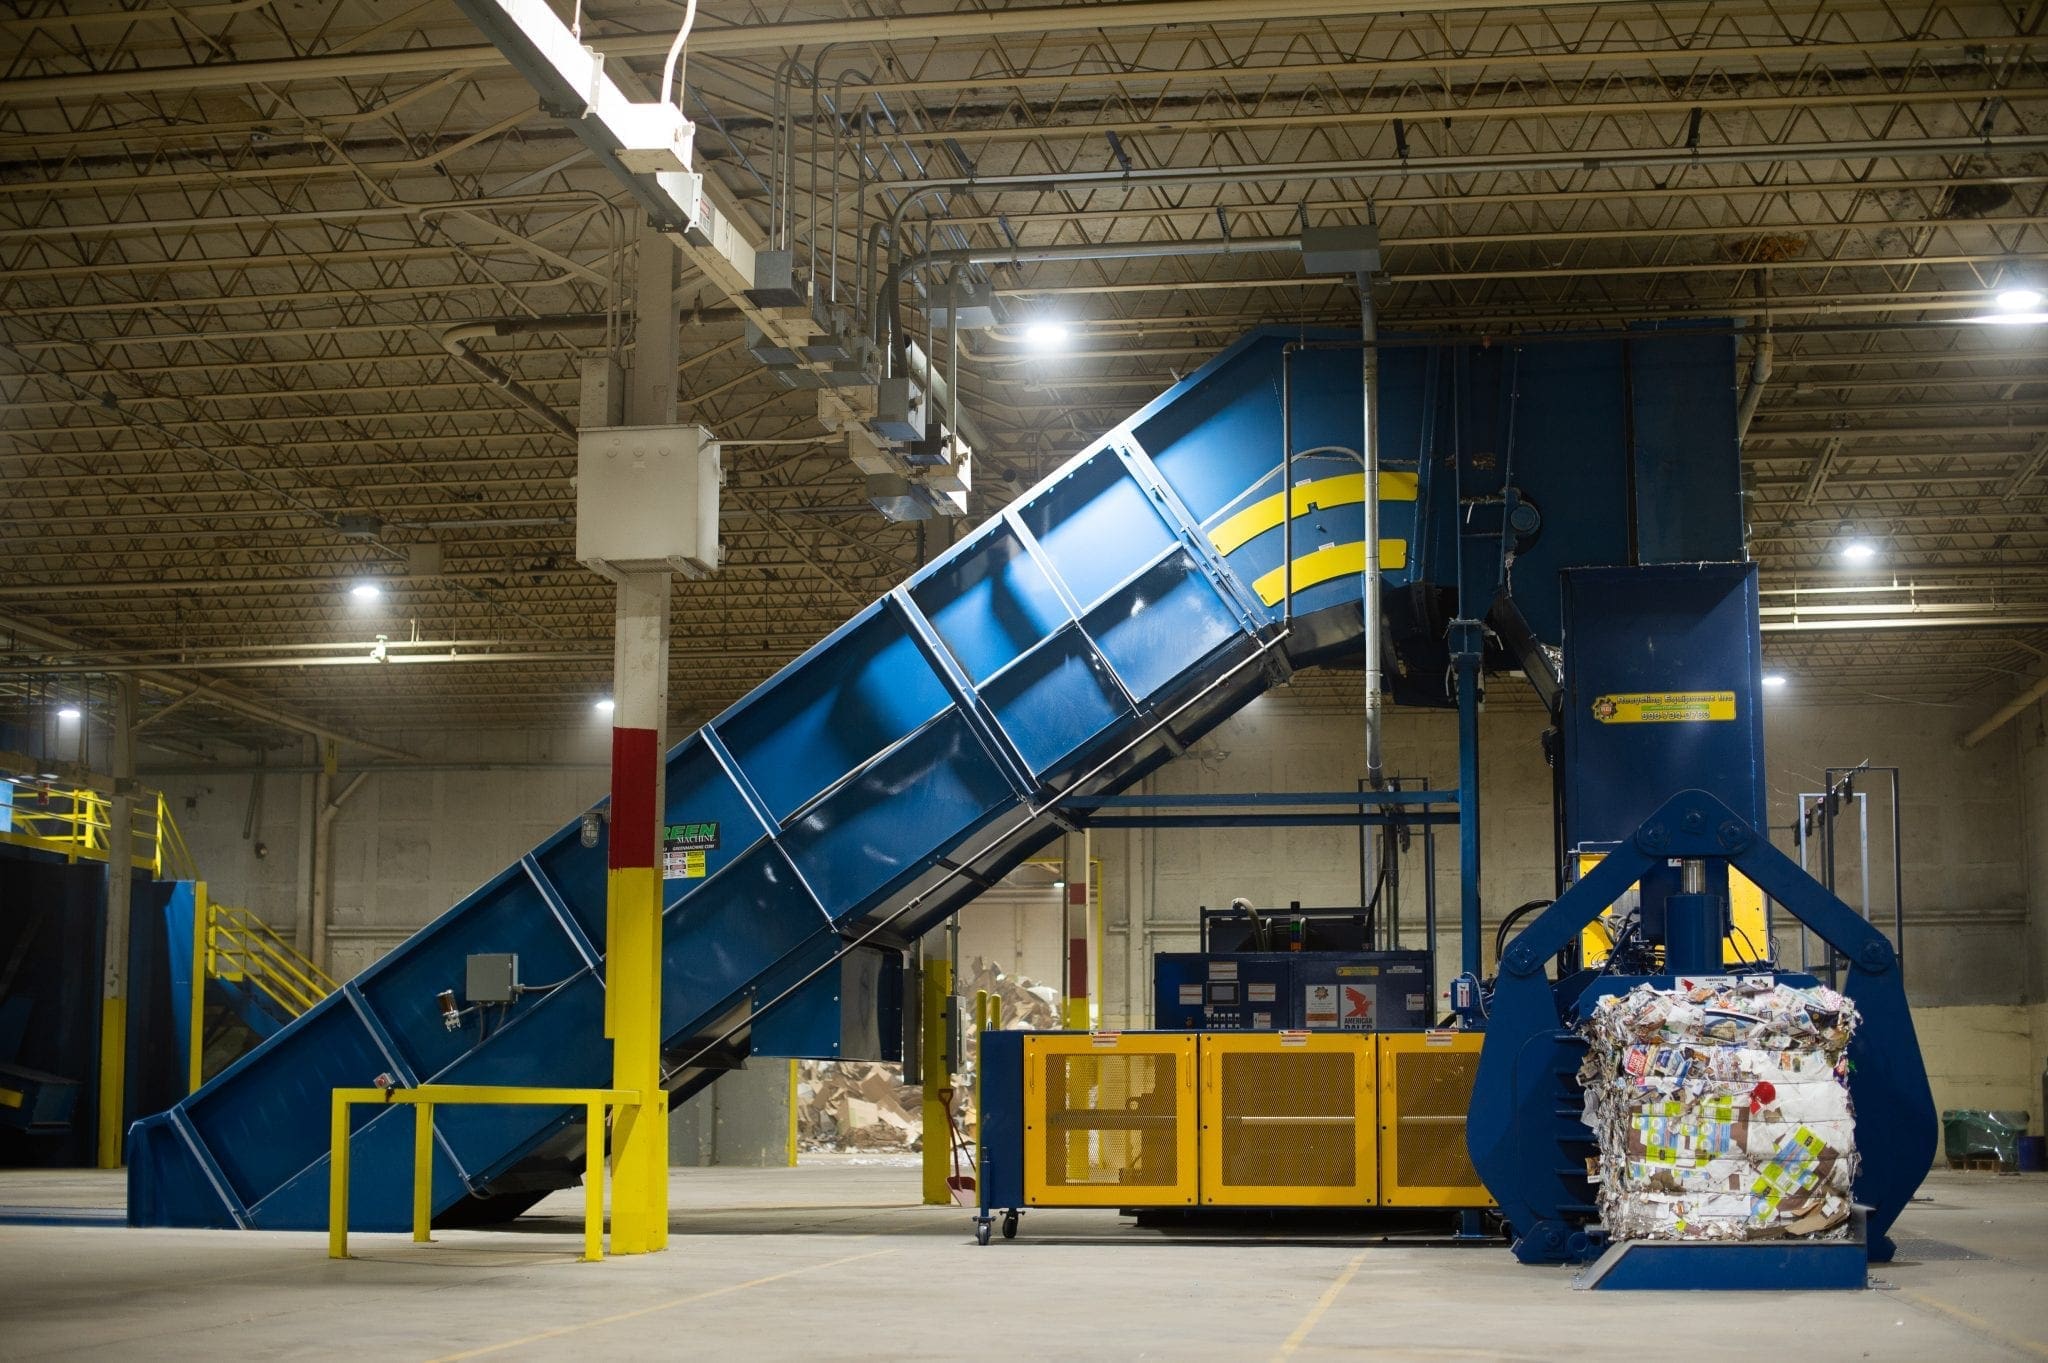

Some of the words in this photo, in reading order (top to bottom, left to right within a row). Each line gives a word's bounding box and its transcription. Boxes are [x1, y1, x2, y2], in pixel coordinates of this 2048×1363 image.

[1616, 696, 1662, 705] Recycling
[1664, 695, 1716, 704] Equipment
[663, 823, 717, 840] REEN
[677, 835, 715, 844] MACHINE
